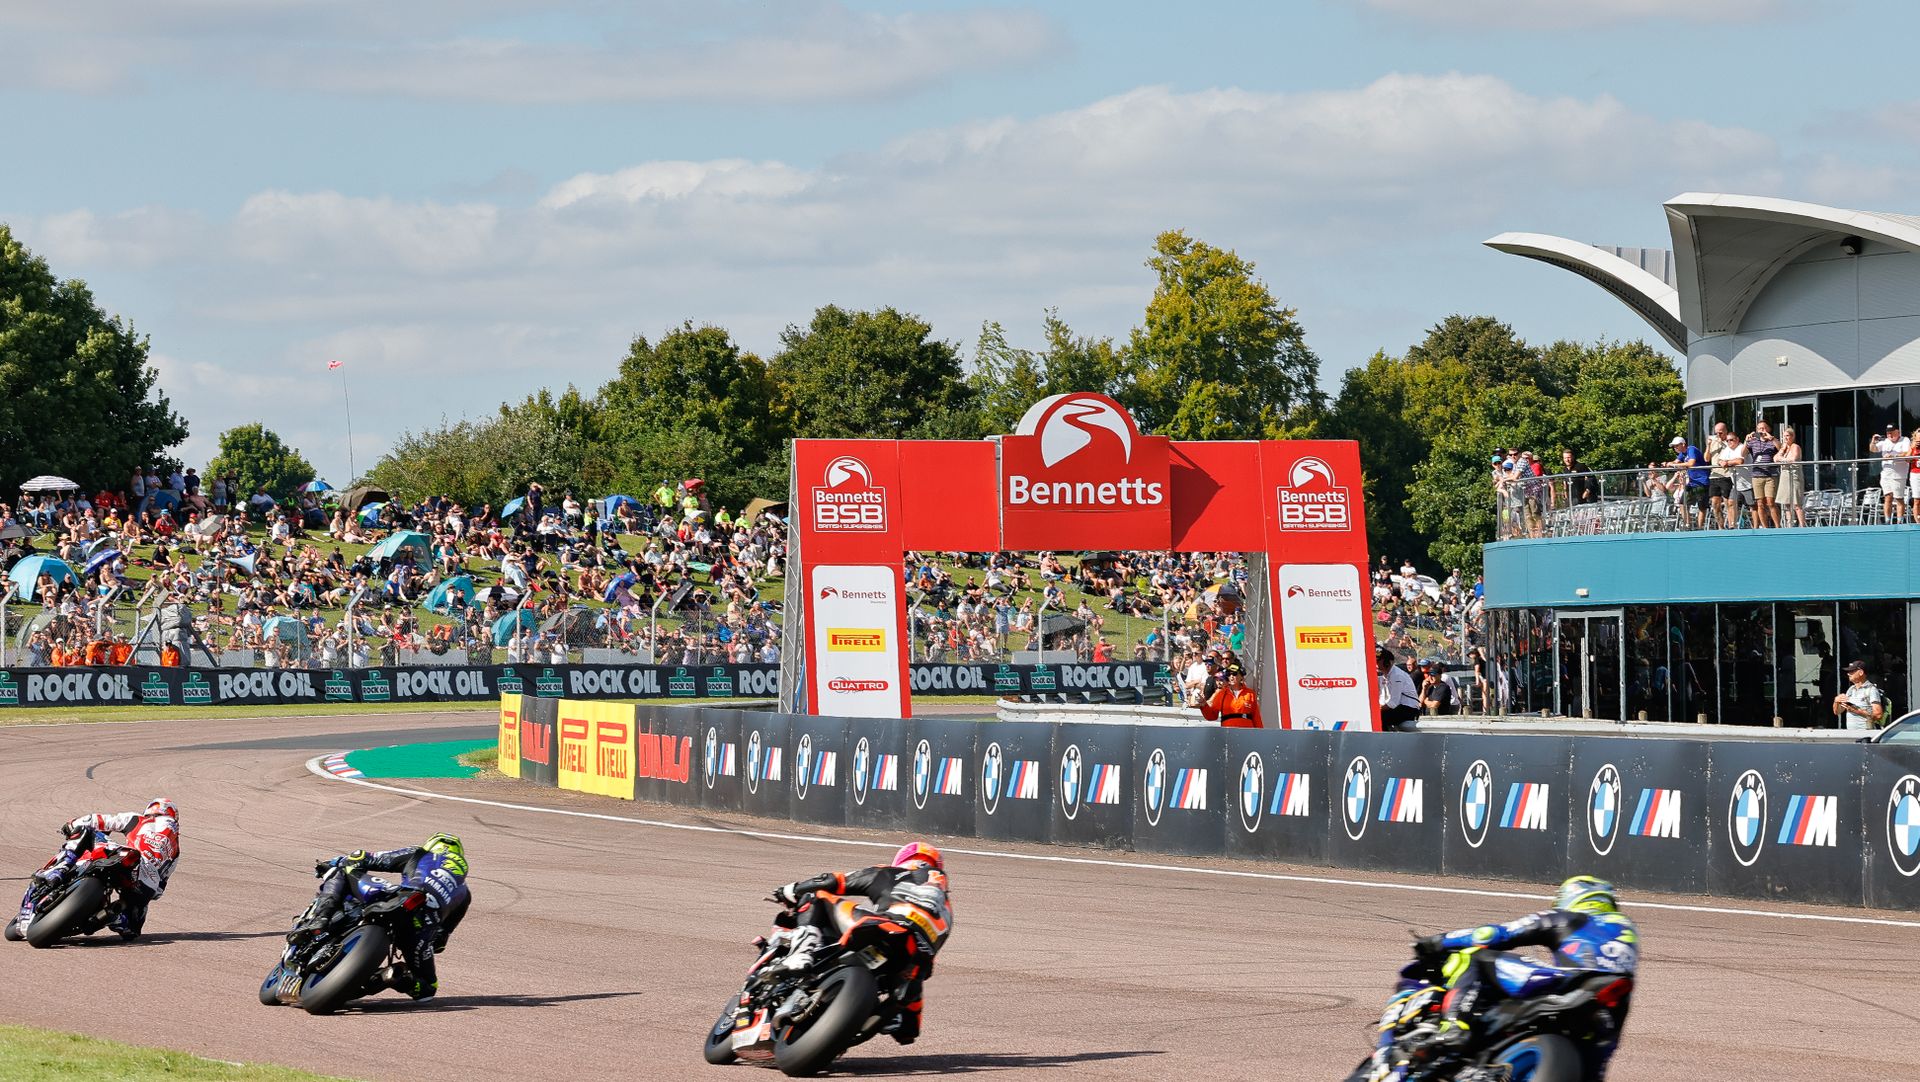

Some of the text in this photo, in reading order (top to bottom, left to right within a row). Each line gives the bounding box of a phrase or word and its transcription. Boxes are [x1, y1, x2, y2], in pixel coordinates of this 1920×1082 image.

[815, 490, 882, 503] Bennetts
[1009, 475, 1163, 505] Bennetts
[1280, 490, 1346, 503] Bennetts
[816, 504, 883, 523] BSB
[1281, 504, 1347, 523] BSB
[842, 590, 886, 599] Bennetts
[1308, 588, 1352, 597] Bennetts
[832, 634, 880, 645] PIRELLI
[1300, 632, 1347, 643] PIRELLI
[396, 670, 490, 696] ROCK OIL
[569, 669, 661, 694] ROCK OIL
[738, 669, 780, 694] ROC
[909, 665, 987, 690] ROCK OIL
[1061, 665, 1148, 688] ROCK OIL
[1302, 679, 1353, 687] QUATTRO
[27, 673, 134, 701] ROCK OIL
[219, 671, 316, 699] ROCK OIL
[326, 686, 352, 694] ROCK OIL
[363, 686, 389, 694] ROCK OIL
[670, 682, 695, 690] ROCK OIL
[708, 682, 722, 690] ROCK
[831, 682, 884, 690] QUATTRO
[143, 689, 168, 697] ROCK OIL
[183, 689, 210, 697] ROCK OIL
[424, 876, 451, 904] YAMAHA
